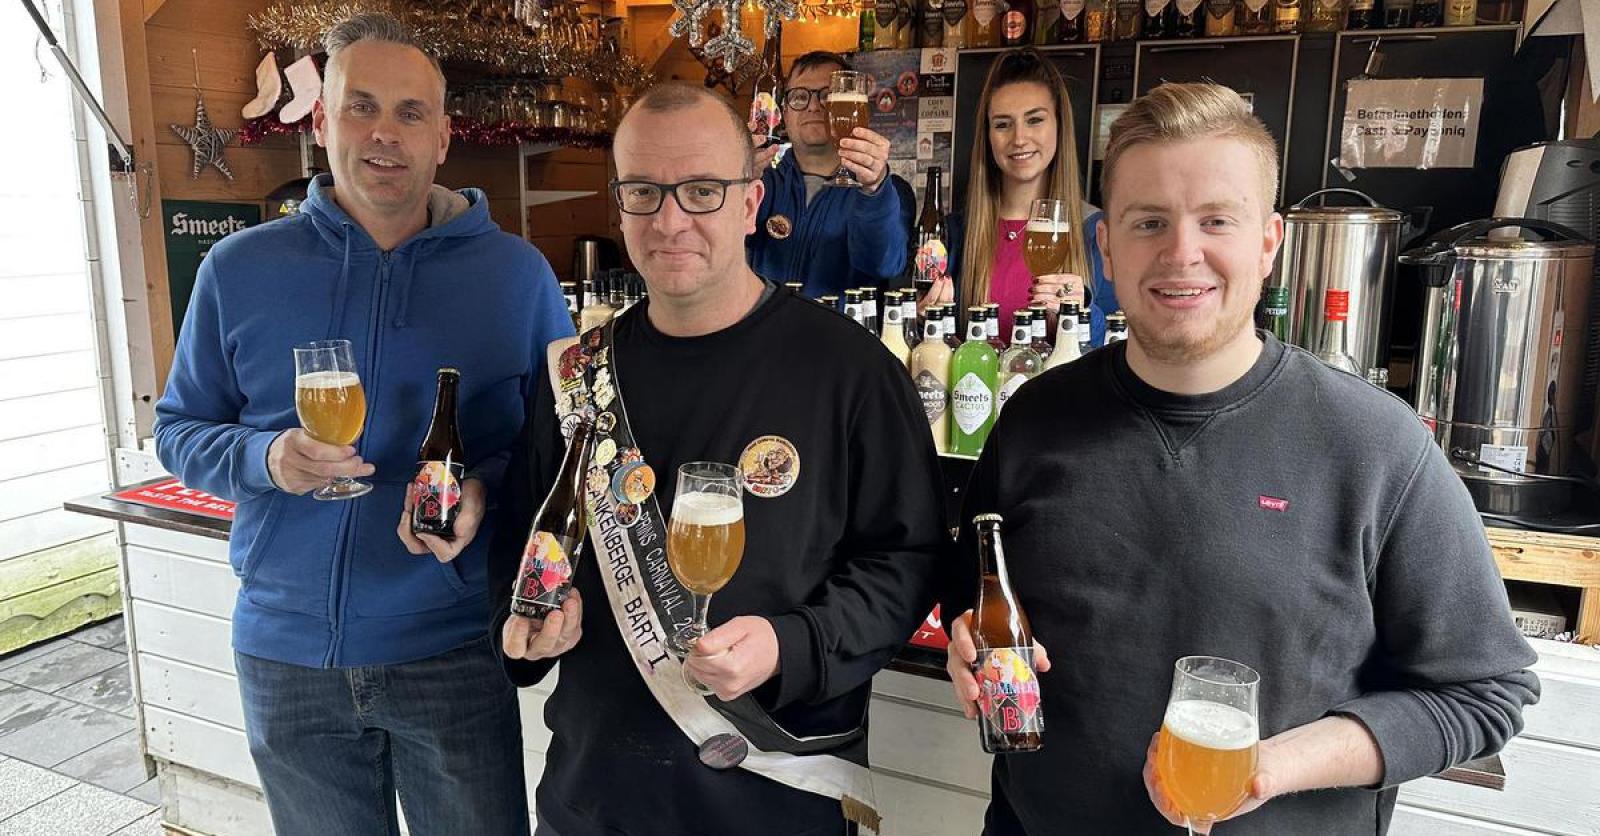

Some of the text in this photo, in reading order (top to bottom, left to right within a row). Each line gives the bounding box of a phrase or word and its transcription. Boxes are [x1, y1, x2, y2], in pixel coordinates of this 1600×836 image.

[1356, 125, 1387, 136] Cash
[171, 212, 246, 236] Smeets
[918, 389, 945, 400] meets
[953, 390, 989, 402] Smeets
[955, 402, 985, 410] CACTUS
[636, 511, 657, 546] PRINS
[646, 547, 684, 615] CARNAVAL
[624, 596, 660, 648] BART
[647, 650, 670, 670] I
